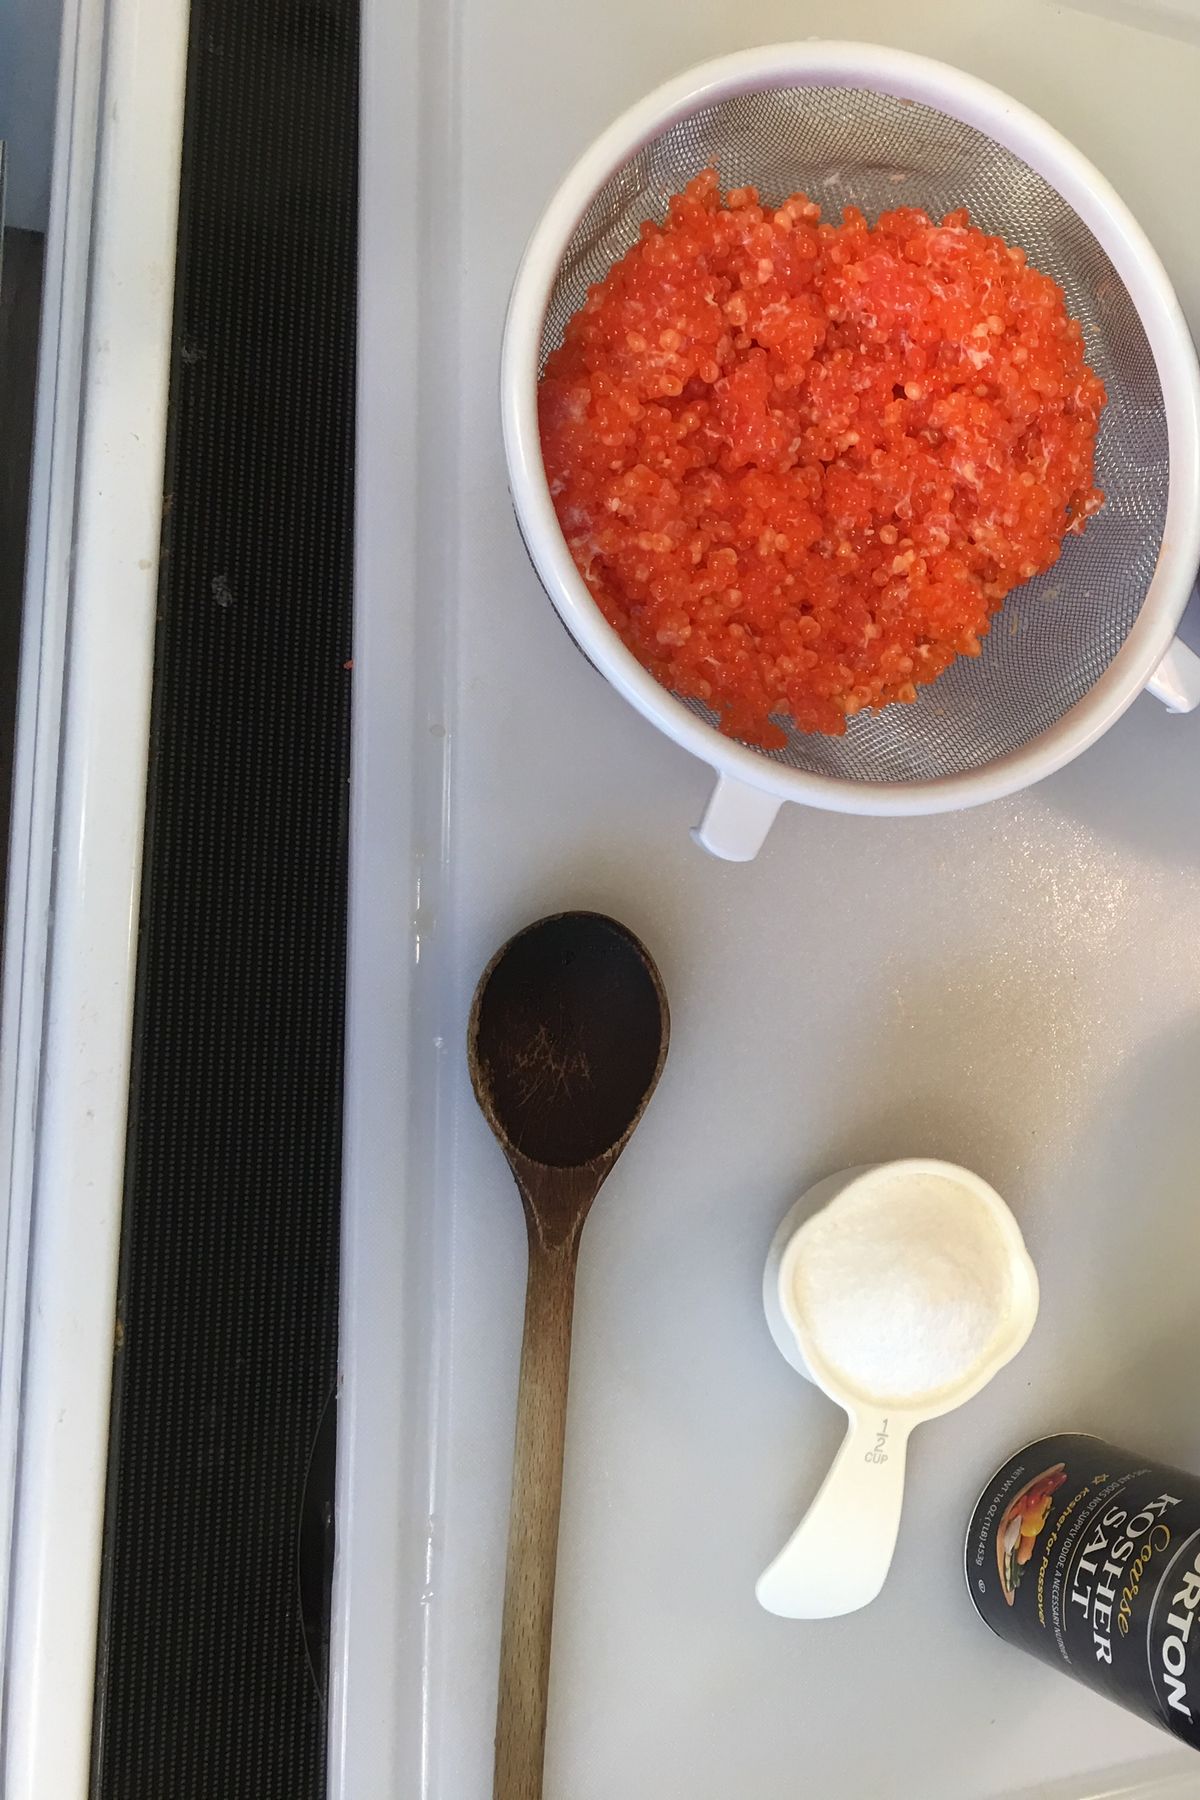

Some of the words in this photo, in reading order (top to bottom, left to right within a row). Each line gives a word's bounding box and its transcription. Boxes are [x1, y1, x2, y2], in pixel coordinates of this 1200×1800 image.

[864, 1451, 889, 1465] CUP
[1011, 1466, 1025, 1480] NET
[993, 1493, 1003, 1503] 16
[1001, 1480, 1012, 1492] WT
[1098, 1482, 1120, 1498] DOES
[987, 1504, 997, 1517] OZ
[1055, 1487, 1090, 1532] Kosher
[1086, 1497, 1102, 1511] NOT
[1068, 1510, 1090, 1538] SUPPLY
[975, 1542, 986, 1566] 453g
[1045, 1531, 1058, 1556] for
[1055, 1538, 1074, 1569] IODIDE,
[1071, 1506, 1128, 1619] SALT
[1093, 1493, 1183, 1665] KOSHER
[1117, 1524, 1171, 1637] Coarse
[1036, 1556, 1049, 1628] Passover
[1051, 1578, 1062, 1629] NECESSARY
